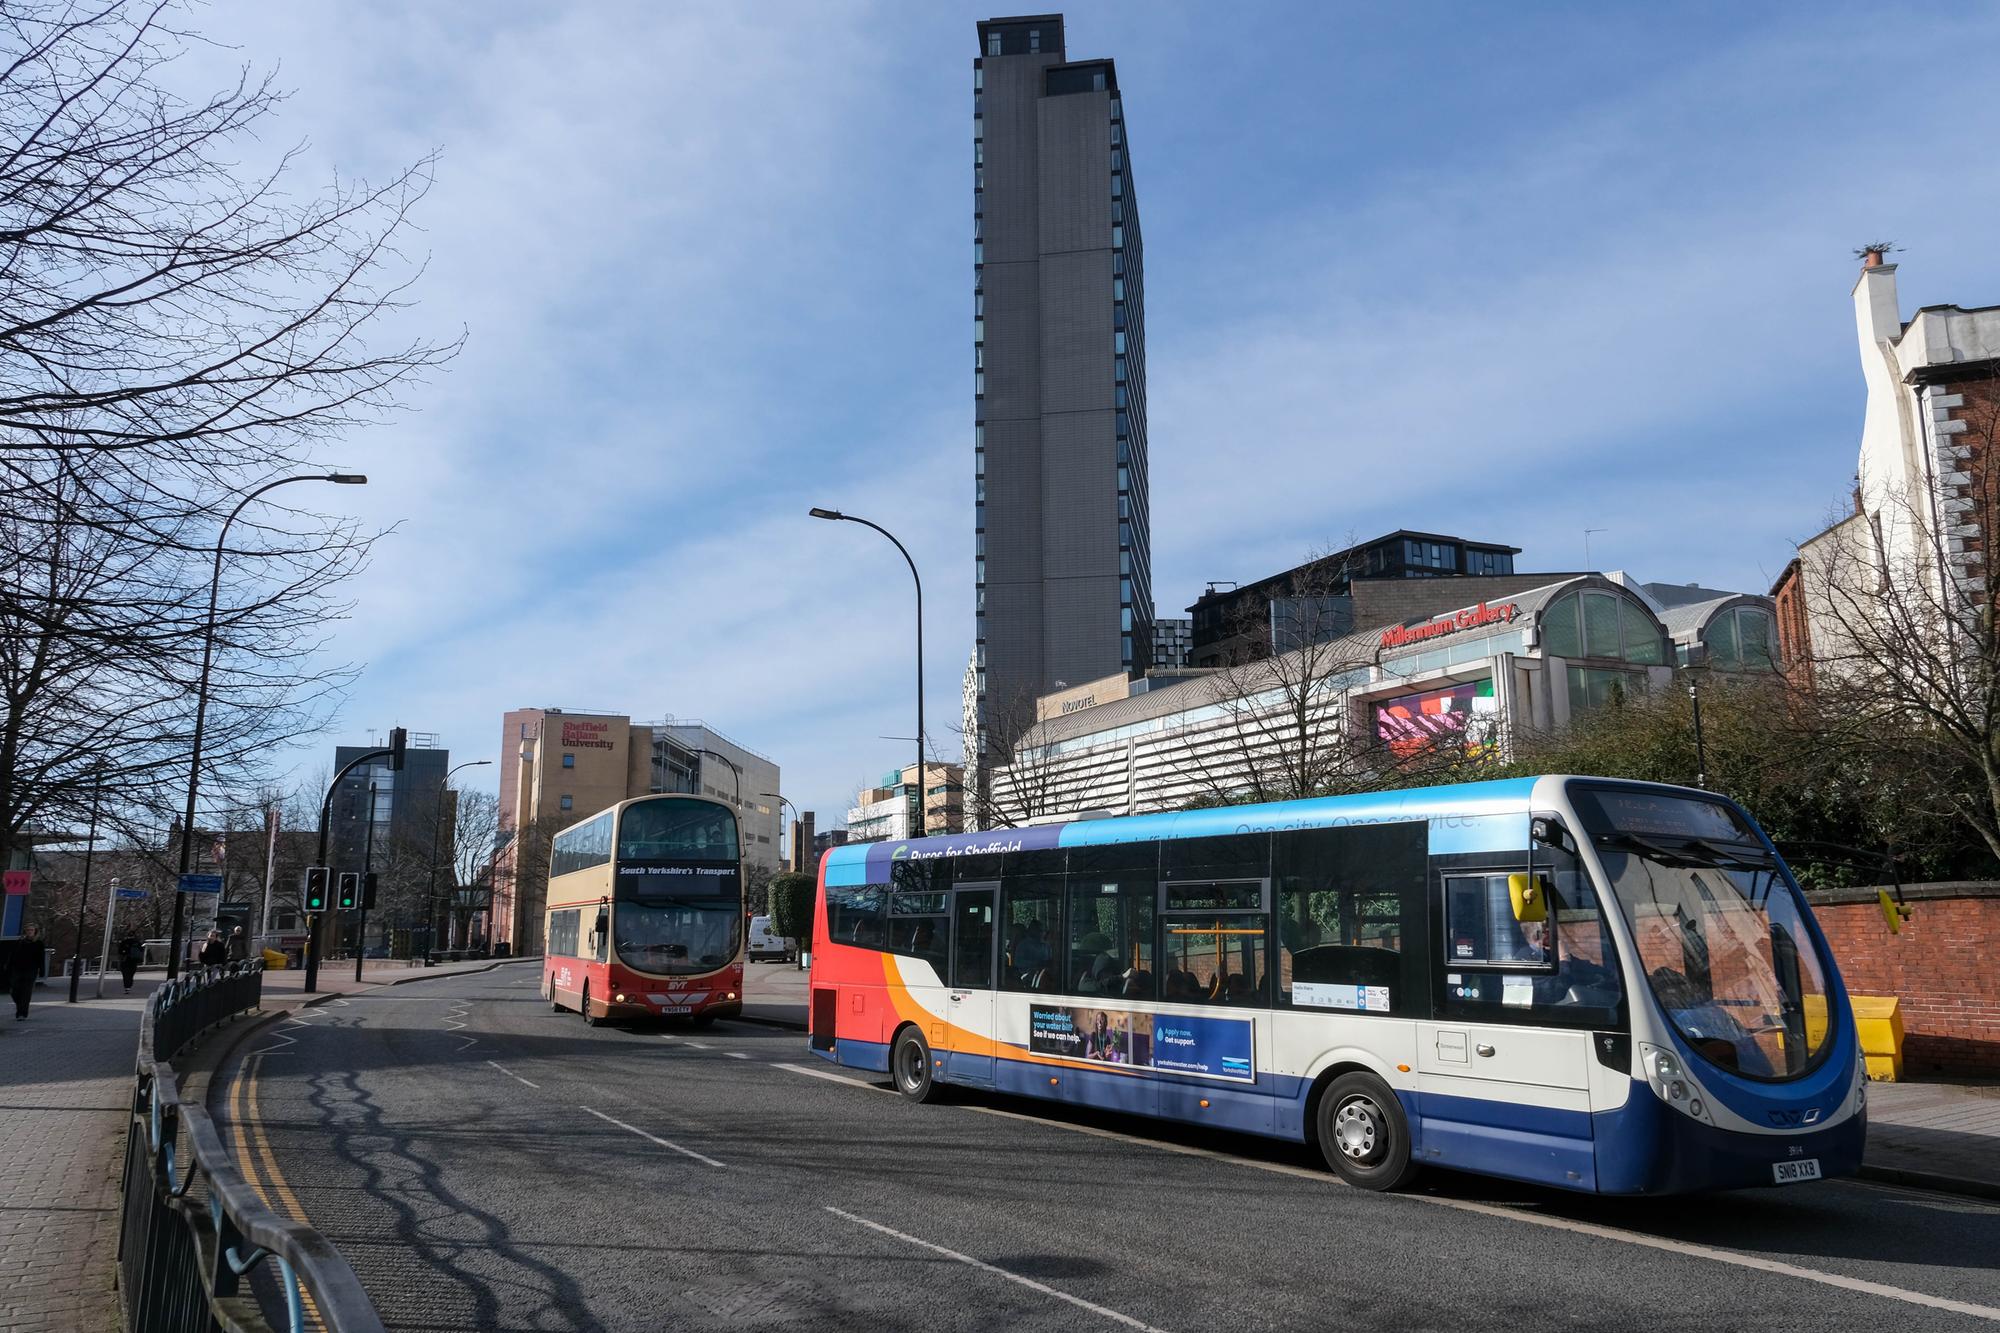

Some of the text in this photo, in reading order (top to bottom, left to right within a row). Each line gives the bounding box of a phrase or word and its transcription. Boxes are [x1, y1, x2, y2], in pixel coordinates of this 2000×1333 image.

[1381, 602, 1514, 648] Millennium Gallery
[1062, 694, 1097, 713] NOVOTEL
[562, 721, 608, 731] Sheffield
[562, 730, 598, 740] Hallam
[561, 739, 614, 751] University
[620, 867, 736, 876] South Yorkshire's Transport
[1033, 1011, 1071, 1022] Worried about
[1033, 1030, 1043, 1038] See
[1067, 1033, 1081, 1044] help.
[1164, 1028, 1179, 1037] Apply
[1164, 1036, 1195, 1046] Get support.
